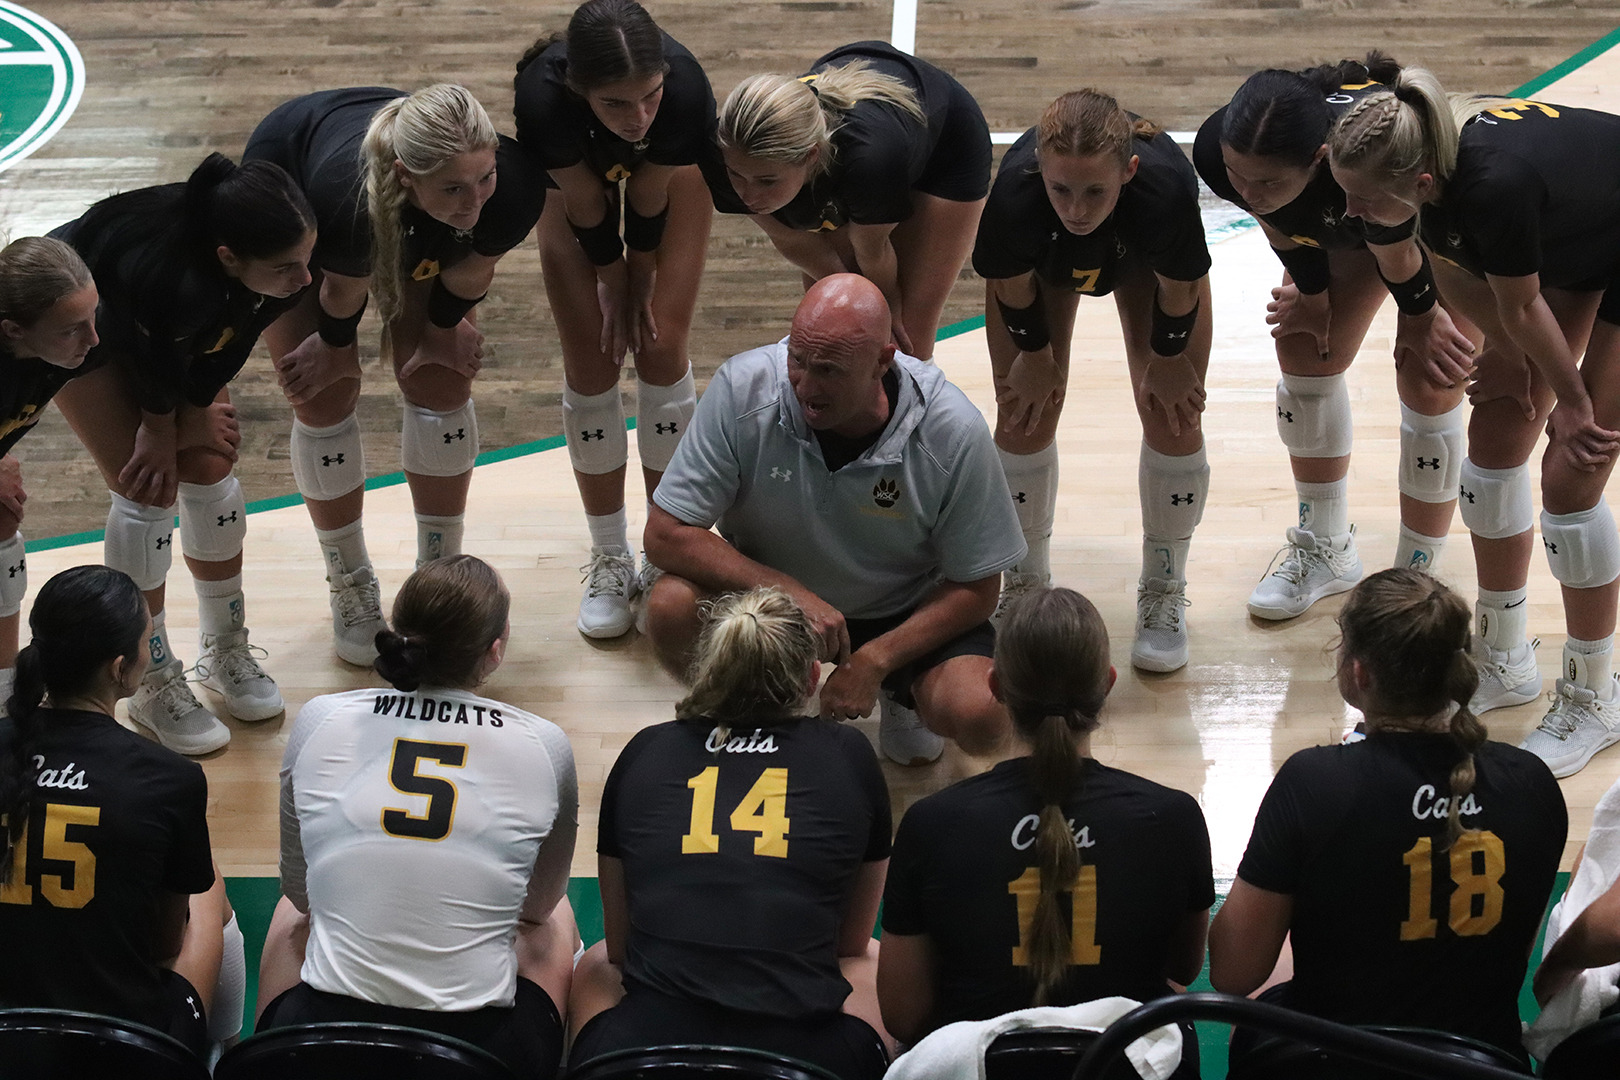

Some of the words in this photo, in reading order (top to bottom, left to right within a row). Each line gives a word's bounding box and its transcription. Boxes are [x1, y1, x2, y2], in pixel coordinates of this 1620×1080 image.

[1071, 266, 1102, 292] 7
[373, 695, 504, 728] WILDCATS
[379, 736, 469, 842] 5
[682, 765, 791, 859] 14
[1411, 784, 1484, 821] Cas
[1010, 814, 1096, 851] Cs
[1007, 864, 1102, 967] 11
[1400, 830, 1507, 941] 18
